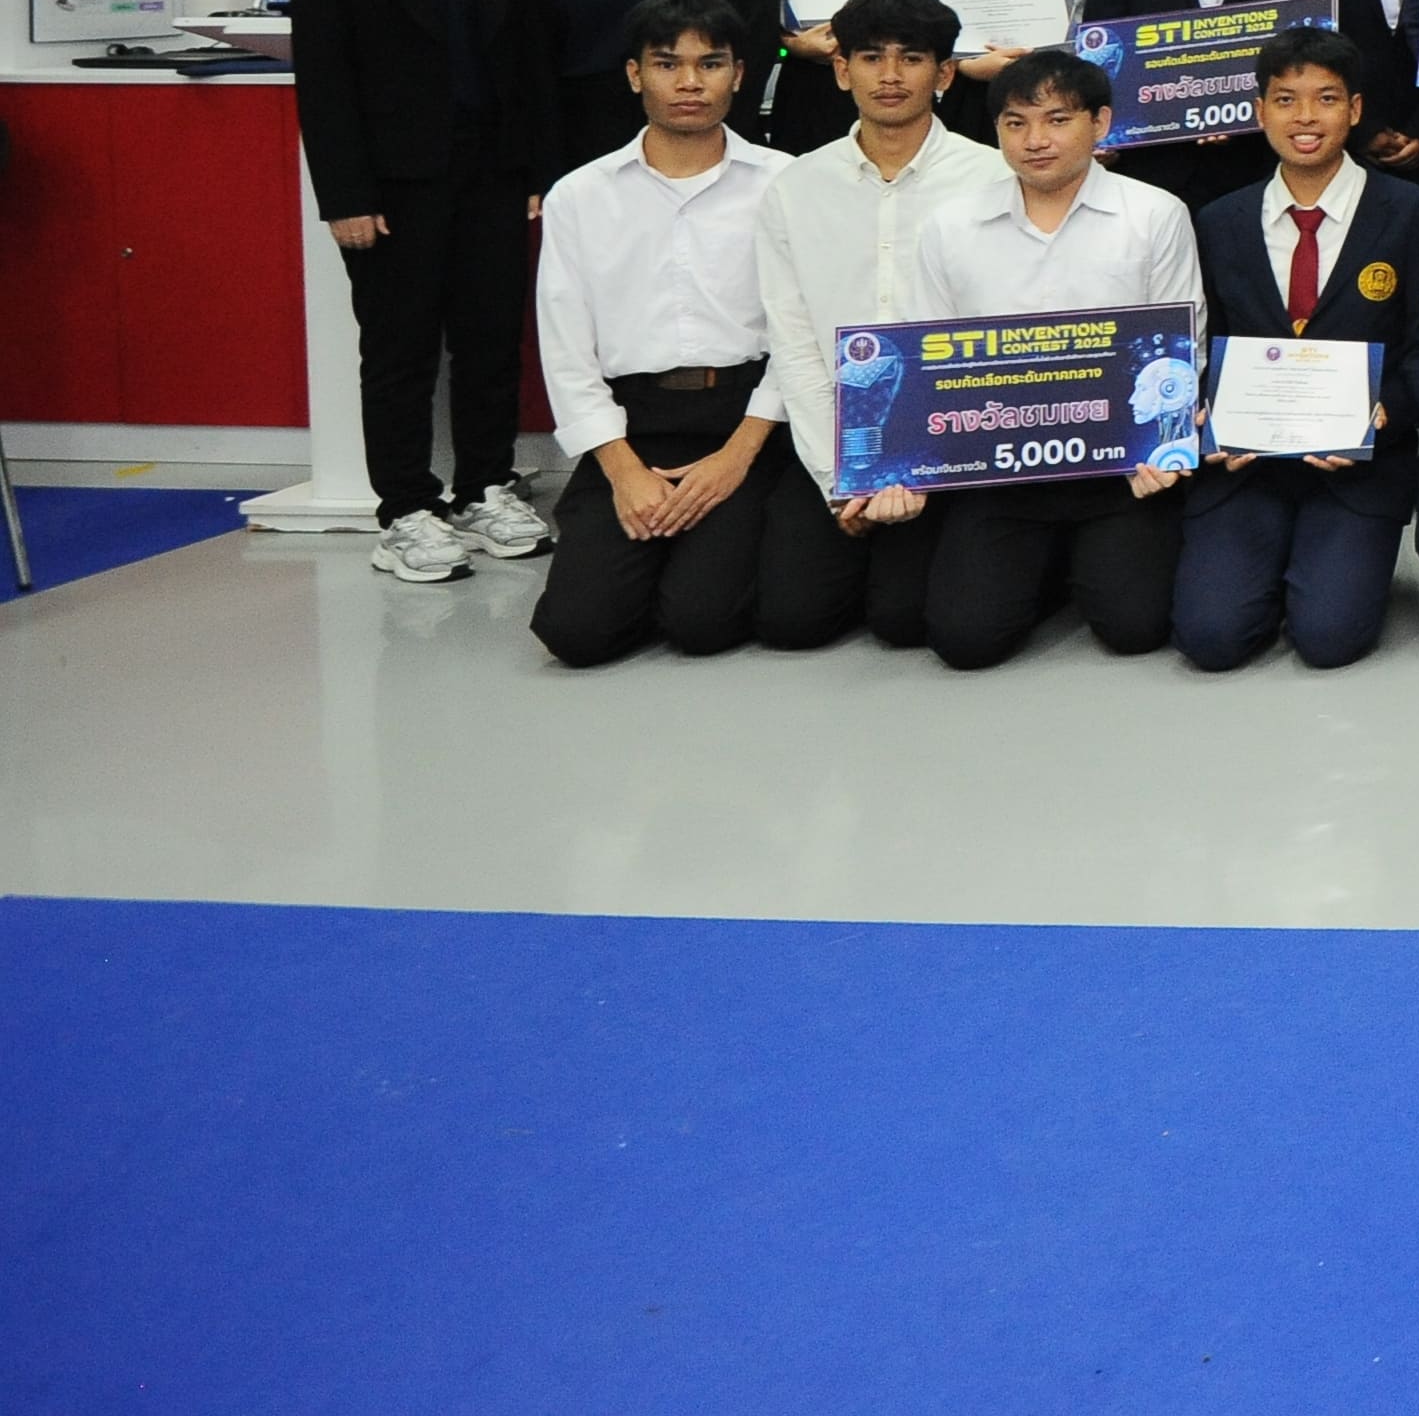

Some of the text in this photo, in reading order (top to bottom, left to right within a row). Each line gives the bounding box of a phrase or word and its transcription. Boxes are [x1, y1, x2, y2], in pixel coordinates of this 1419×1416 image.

[1194, 9, 1278, 28] INVENTIONS
[1136, 20, 1191, 47] STI
[1194, 26, 1242, 39] CONTEST
[1185, 101, 1253, 131] 5,000
[1002, 321, 1117, 342] INVENTIONS
[921, 329, 997, 360] STI
[1003, 340, 1067, 354] CONTEST
[994, 437, 1086, 473] 5,000
[1092, 446, 1125, 461] บาท
